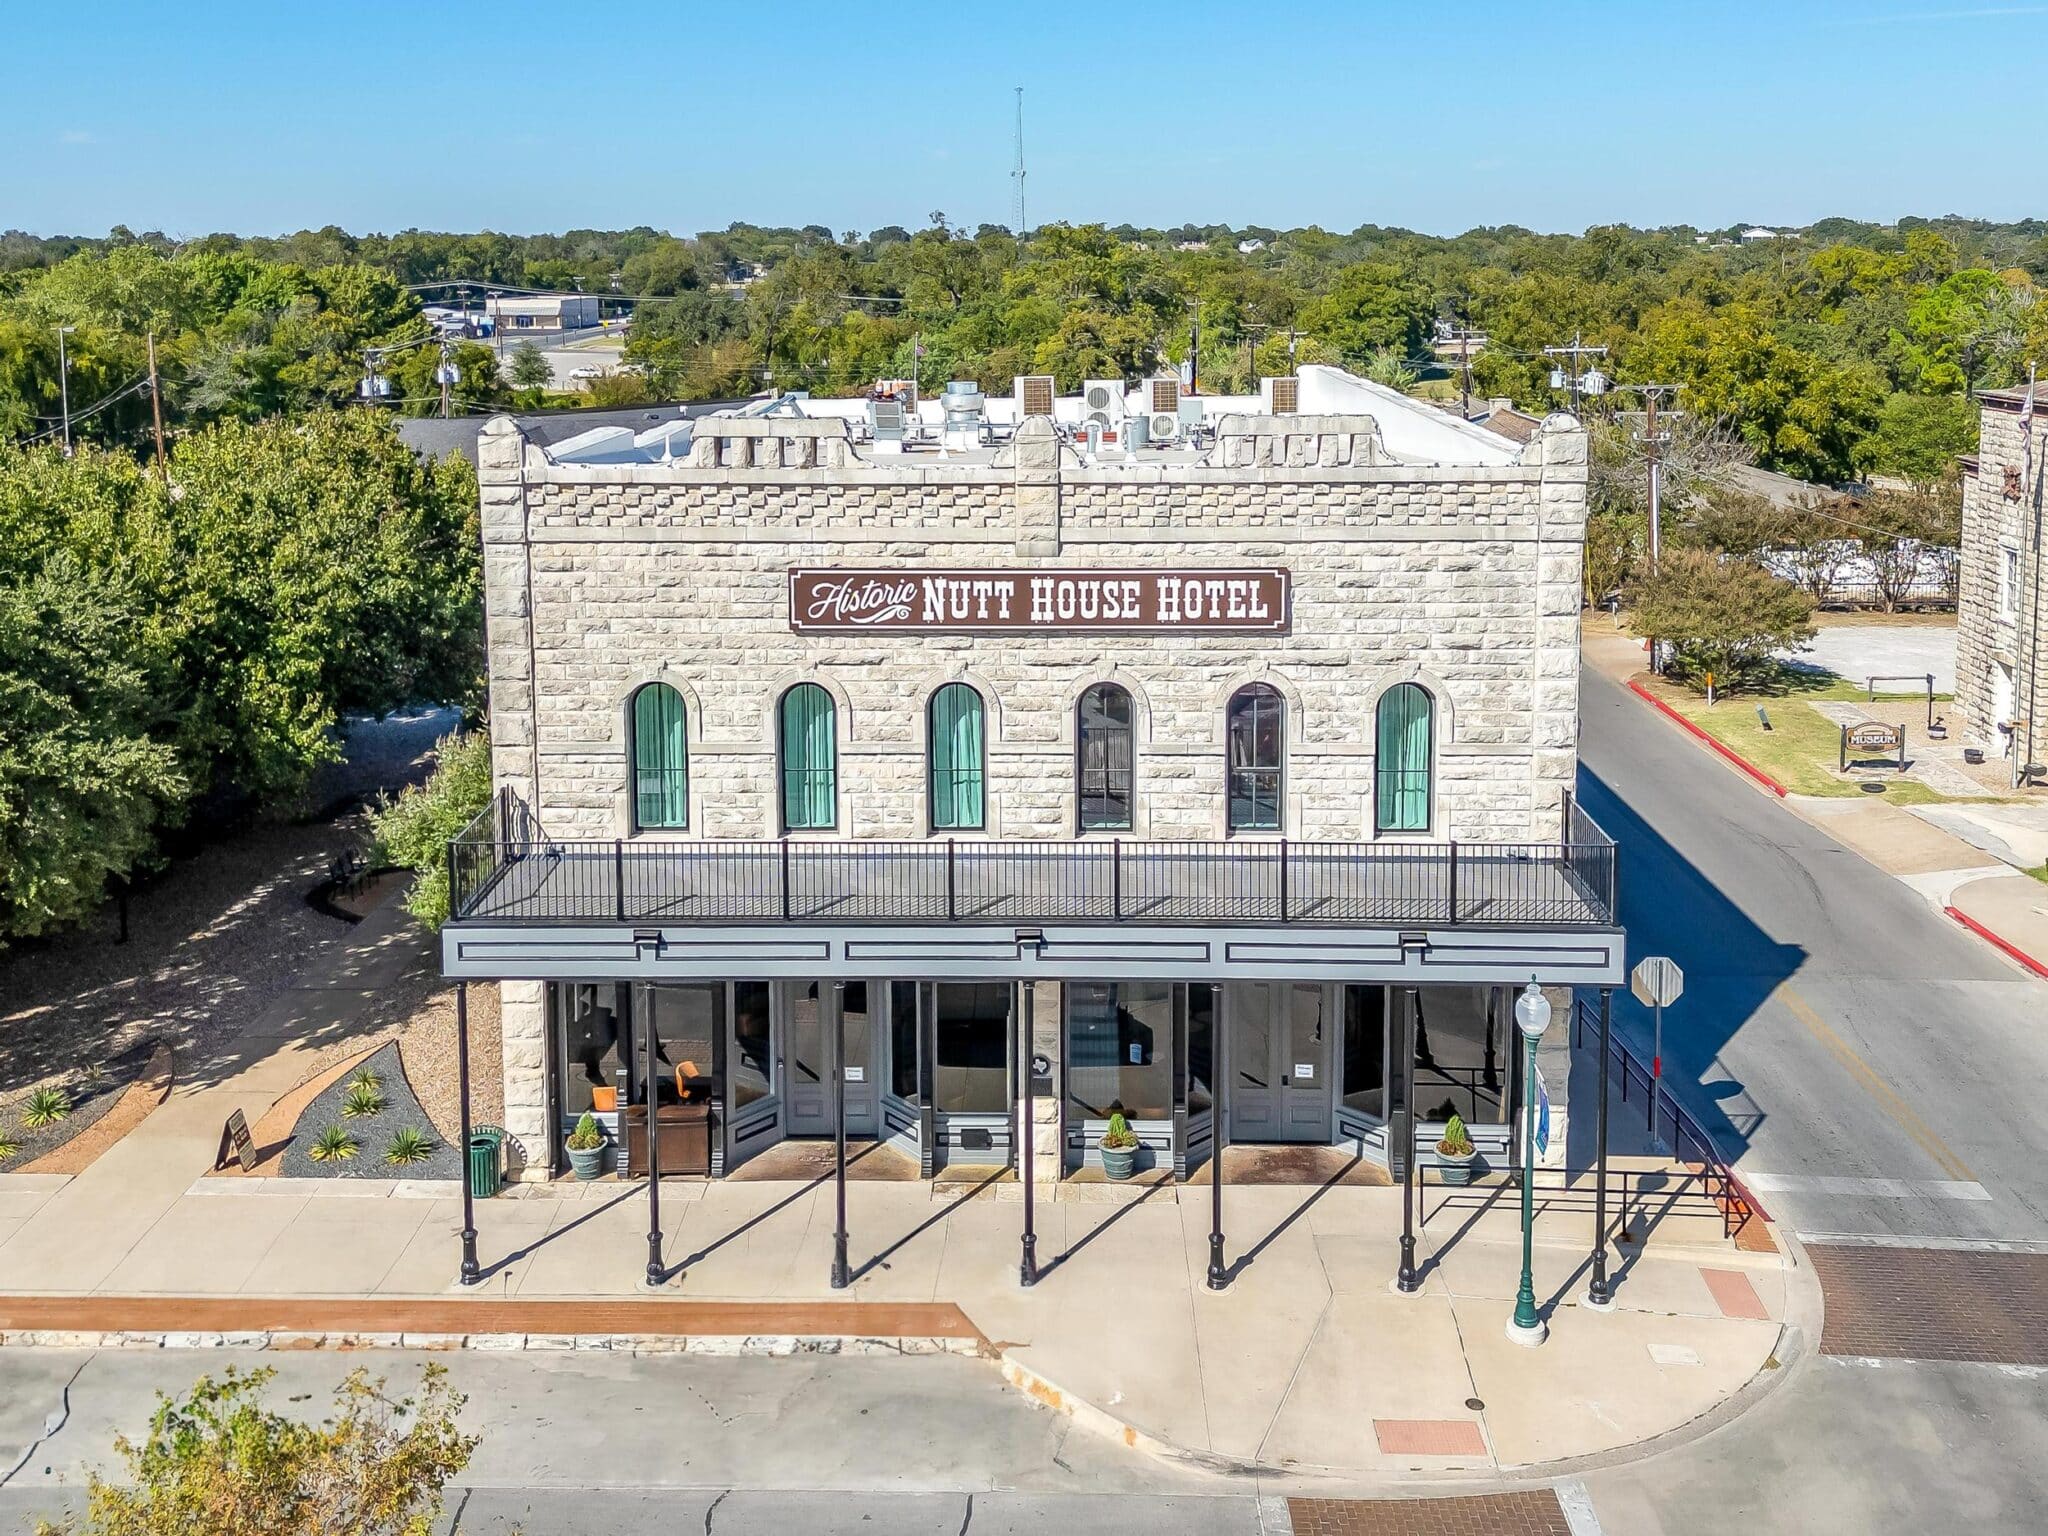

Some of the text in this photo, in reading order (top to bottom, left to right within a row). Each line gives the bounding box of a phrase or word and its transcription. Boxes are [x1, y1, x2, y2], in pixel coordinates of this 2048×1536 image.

[808, 576, 1268, 623] Historic NUTT HOUSE HOTEL
[1851, 735, 1896, 744] MUSEUM
